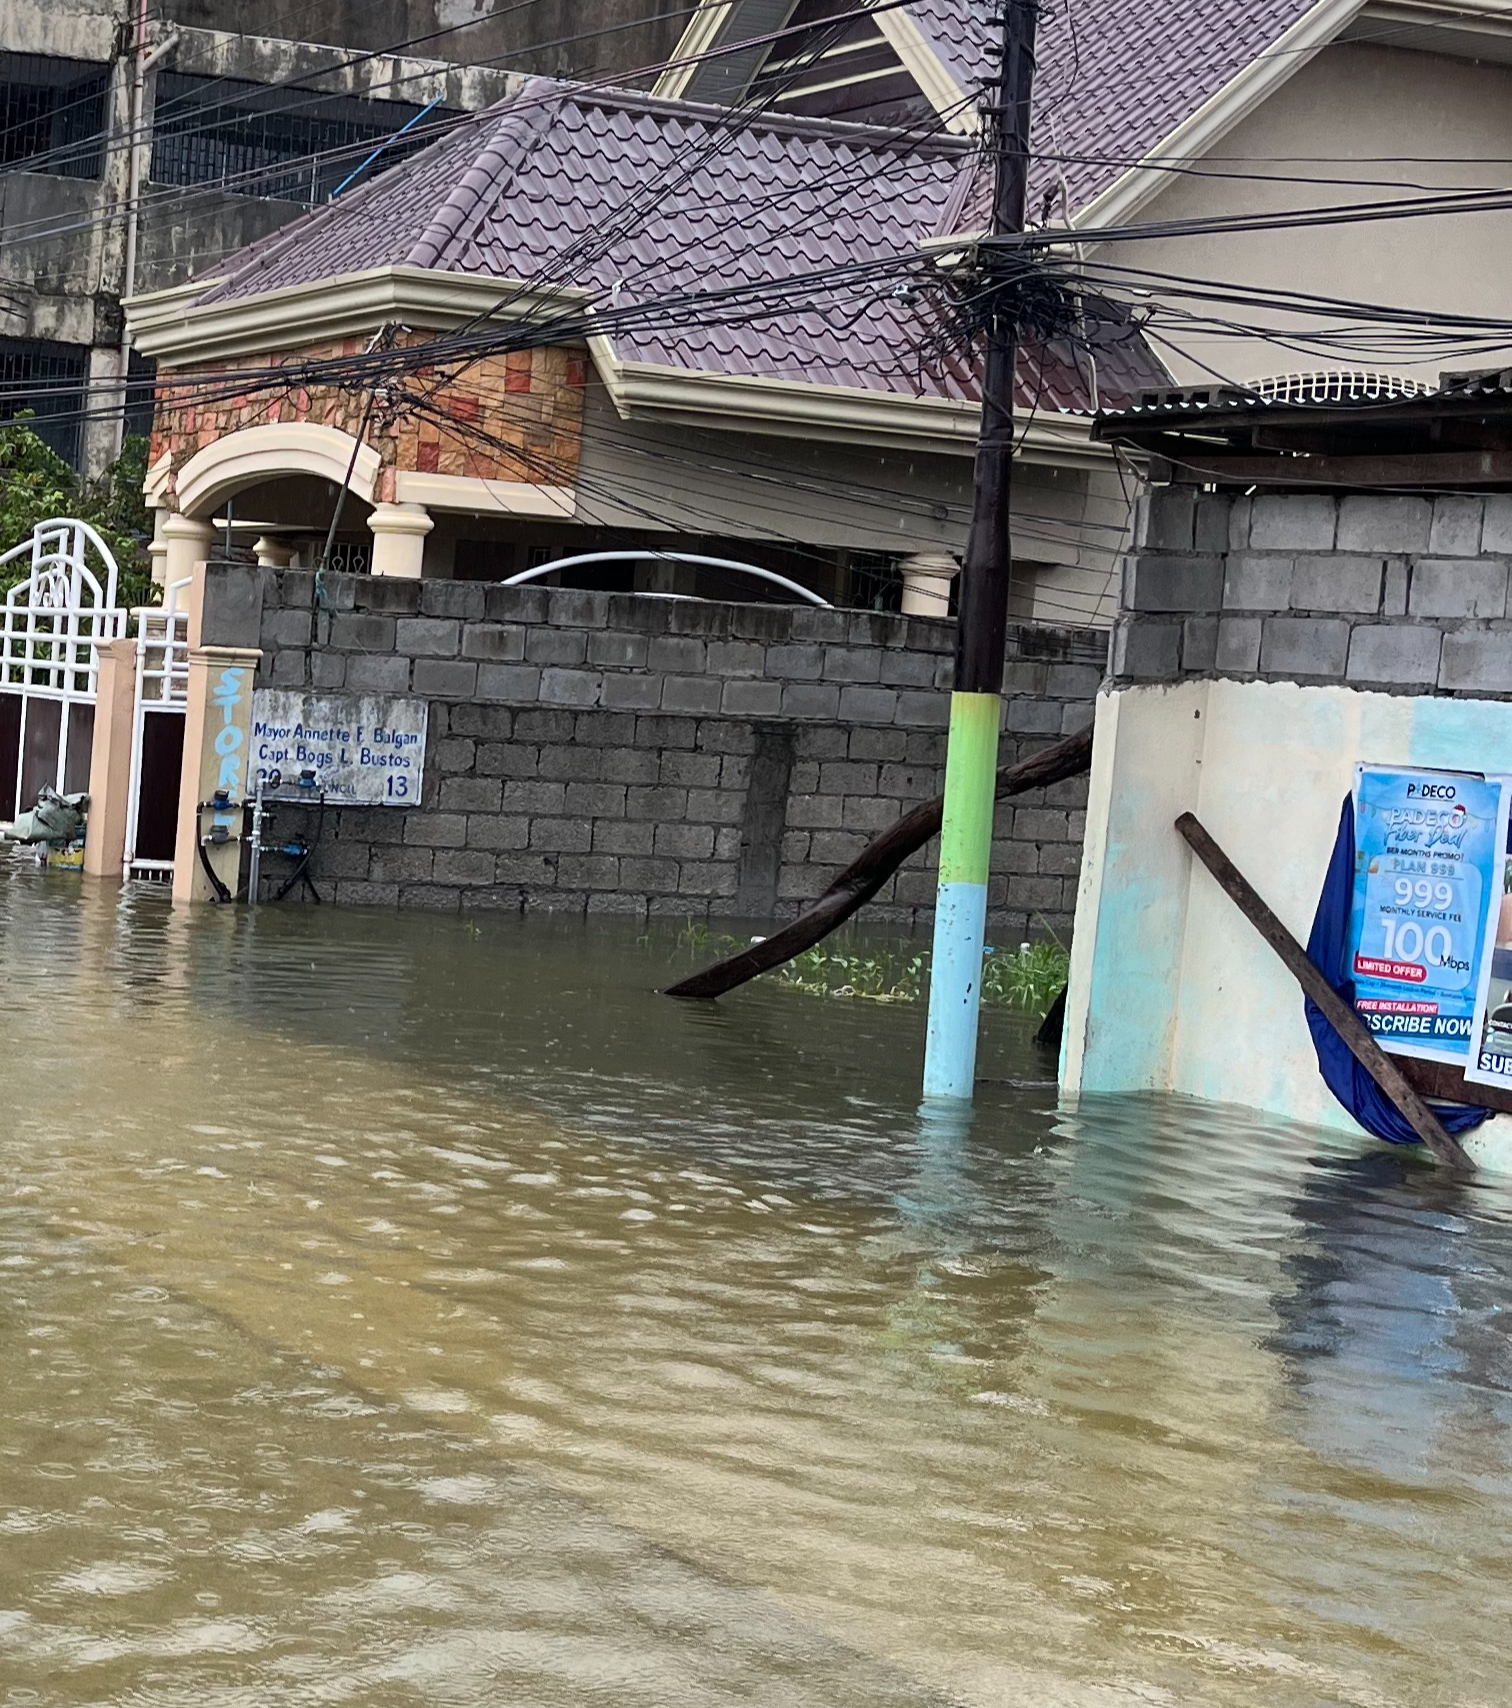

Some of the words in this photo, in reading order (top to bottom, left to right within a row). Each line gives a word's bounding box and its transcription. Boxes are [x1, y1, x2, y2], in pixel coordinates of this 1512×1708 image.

[254, 722, 291, 741] Mayor
[293, 723, 351, 742] Annette
[374, 727, 418, 749] Balgan
[296, 745, 333, 768] Bogs
[360, 747, 411, 768] Bustos
[386, 775, 409, 797] 13
[1390, 806, 1462, 829] PADECO
[1383, 823, 1423, 847] Fiber
[1424, 825, 1468, 849] Deal
[1400, 848, 1431, 857] MONTHS
[1393, 858, 1426, 873] PLAN
[1430, 862, 1455, 876] 999
[1394, 877, 1453, 911] 999
[1379, 905, 1415, 917] MONTHLY
[1416, 907, 1447, 921] SERVICE
[1450, 912, 1462, 922] FEE
[1380, 918, 1453, 967] 100
[1357, 960, 1391, 973] LIMITED
[1393, 964, 1423, 978] OFFER
[1439, 954, 1470, 974] Mbps
[1356, 1000, 1378, 1010] FREE
[1378, 1001, 1438, 1014] INSTALLATION!
[1434, 1017, 1473, 1036] NOW
